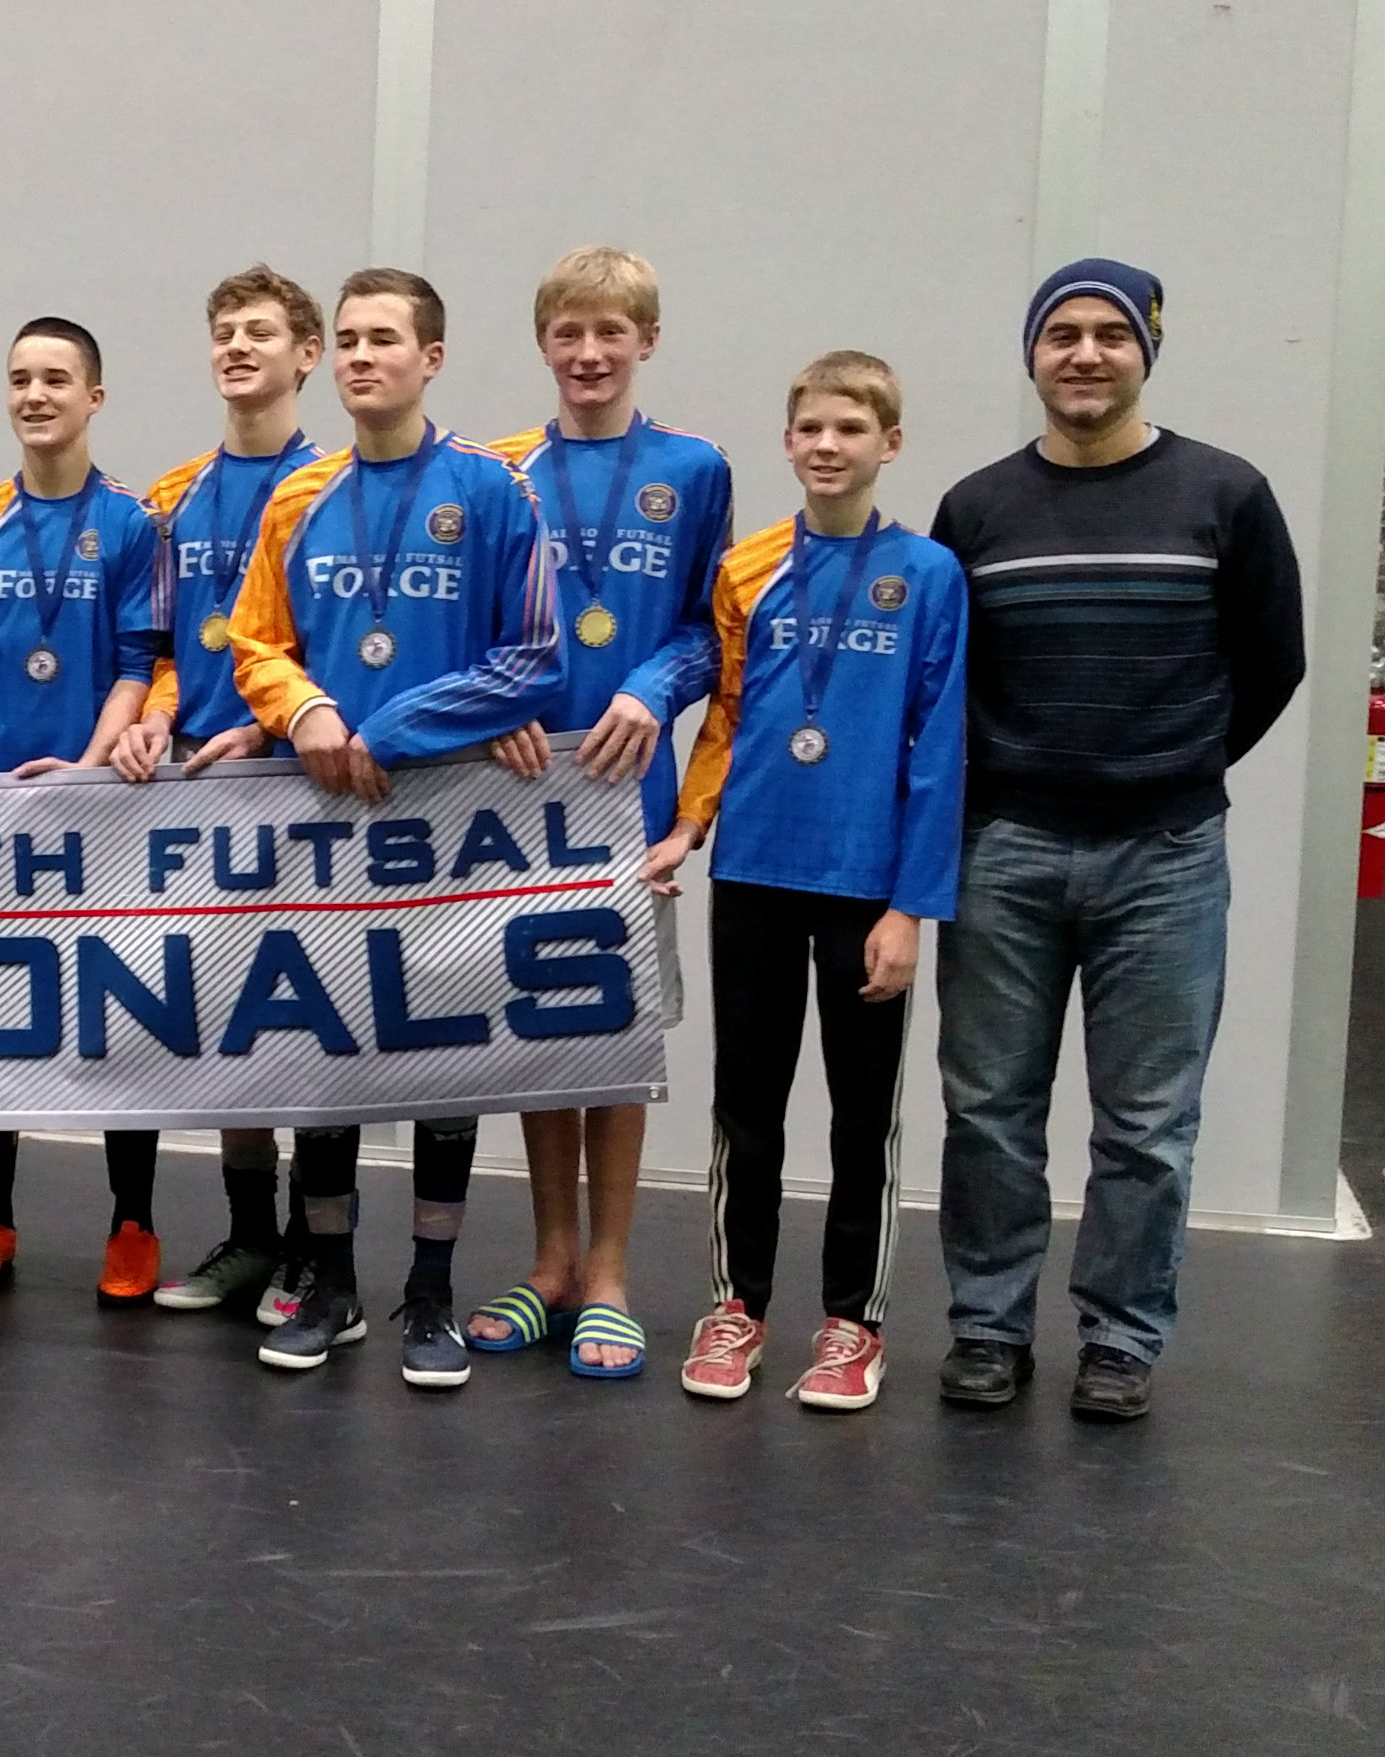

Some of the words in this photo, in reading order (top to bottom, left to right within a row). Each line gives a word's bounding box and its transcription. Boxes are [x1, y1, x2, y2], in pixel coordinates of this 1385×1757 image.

[615, 528, 673, 546] FUTSAL
[405, 552, 464, 567] FUTSAL
[148, 800, 613, 893] FUTSAL
